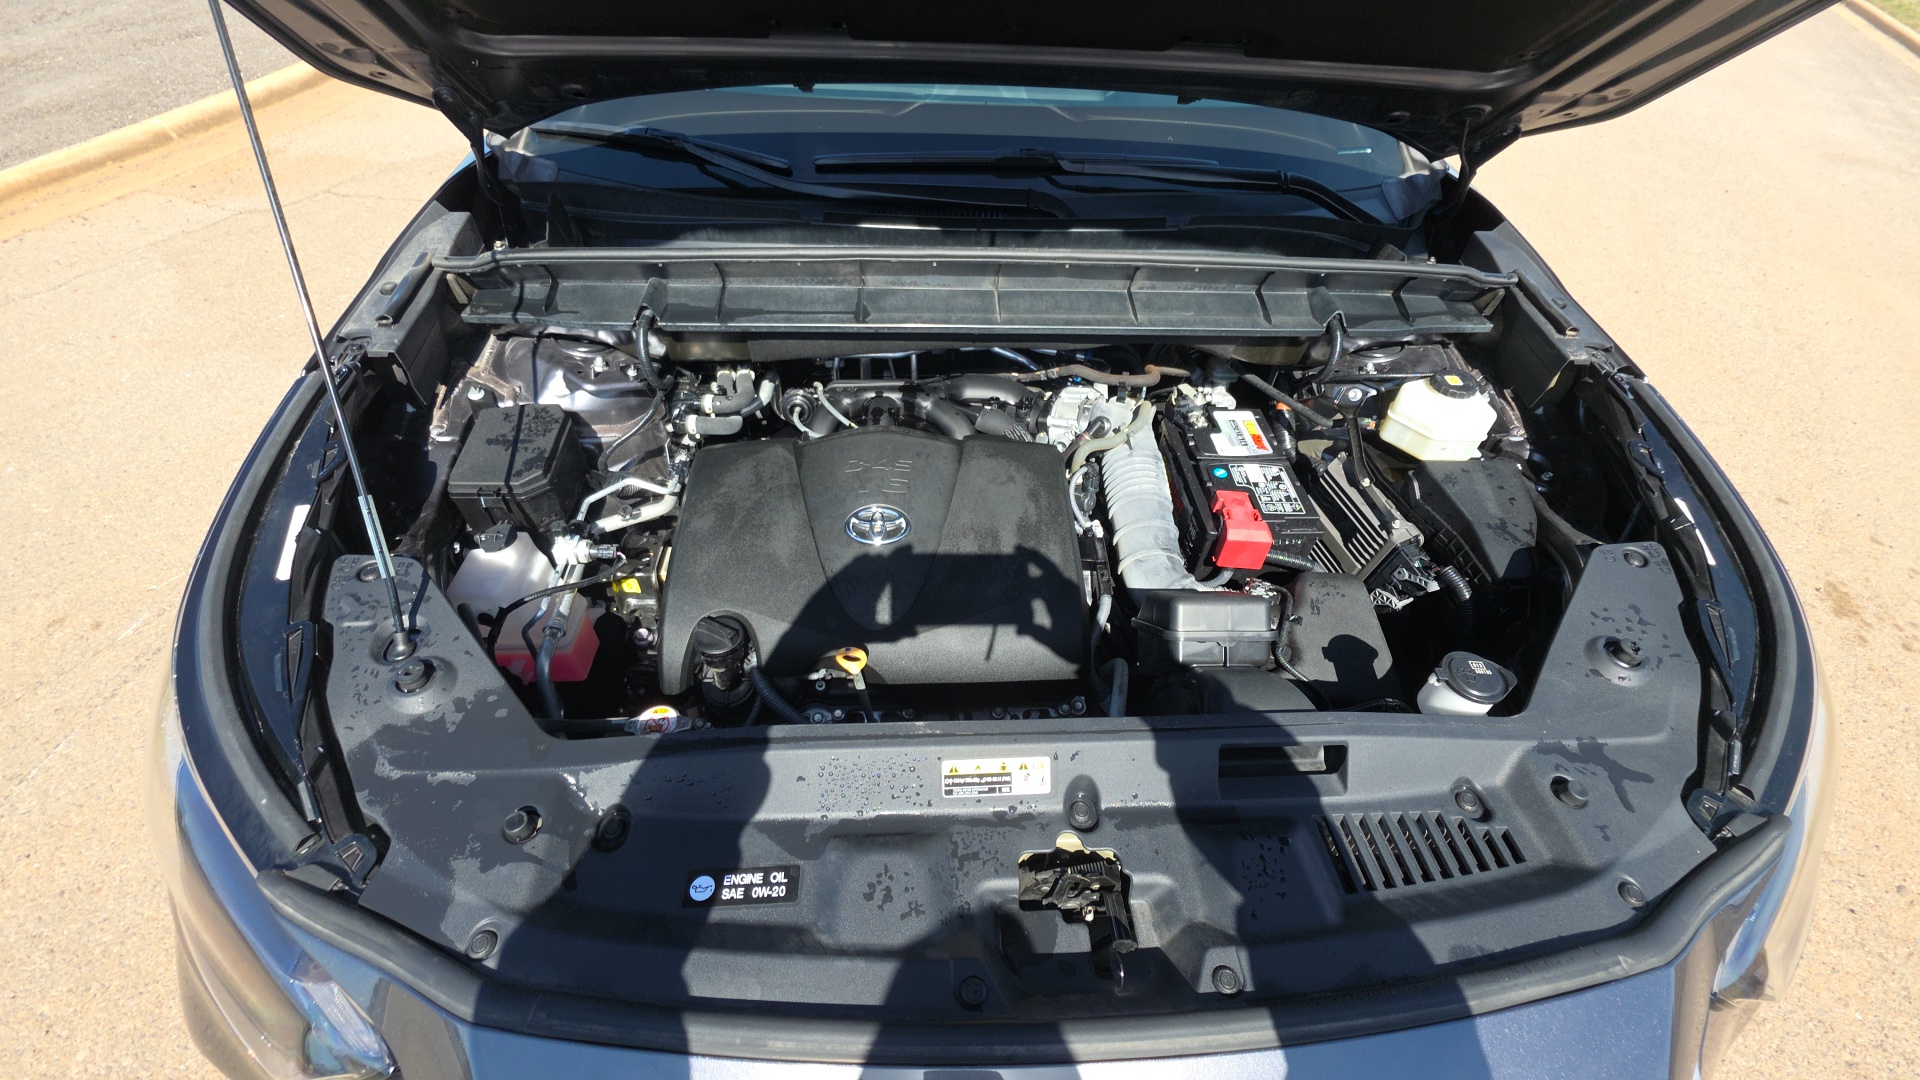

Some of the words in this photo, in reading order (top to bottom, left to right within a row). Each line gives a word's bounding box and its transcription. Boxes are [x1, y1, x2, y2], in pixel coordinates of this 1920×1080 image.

[723, 872, 764, 886] ENGINE
[770, 871, 788, 883] OIL
[721, 887, 745, 900] SAE
[751, 885, 786, 899] 0W-20
